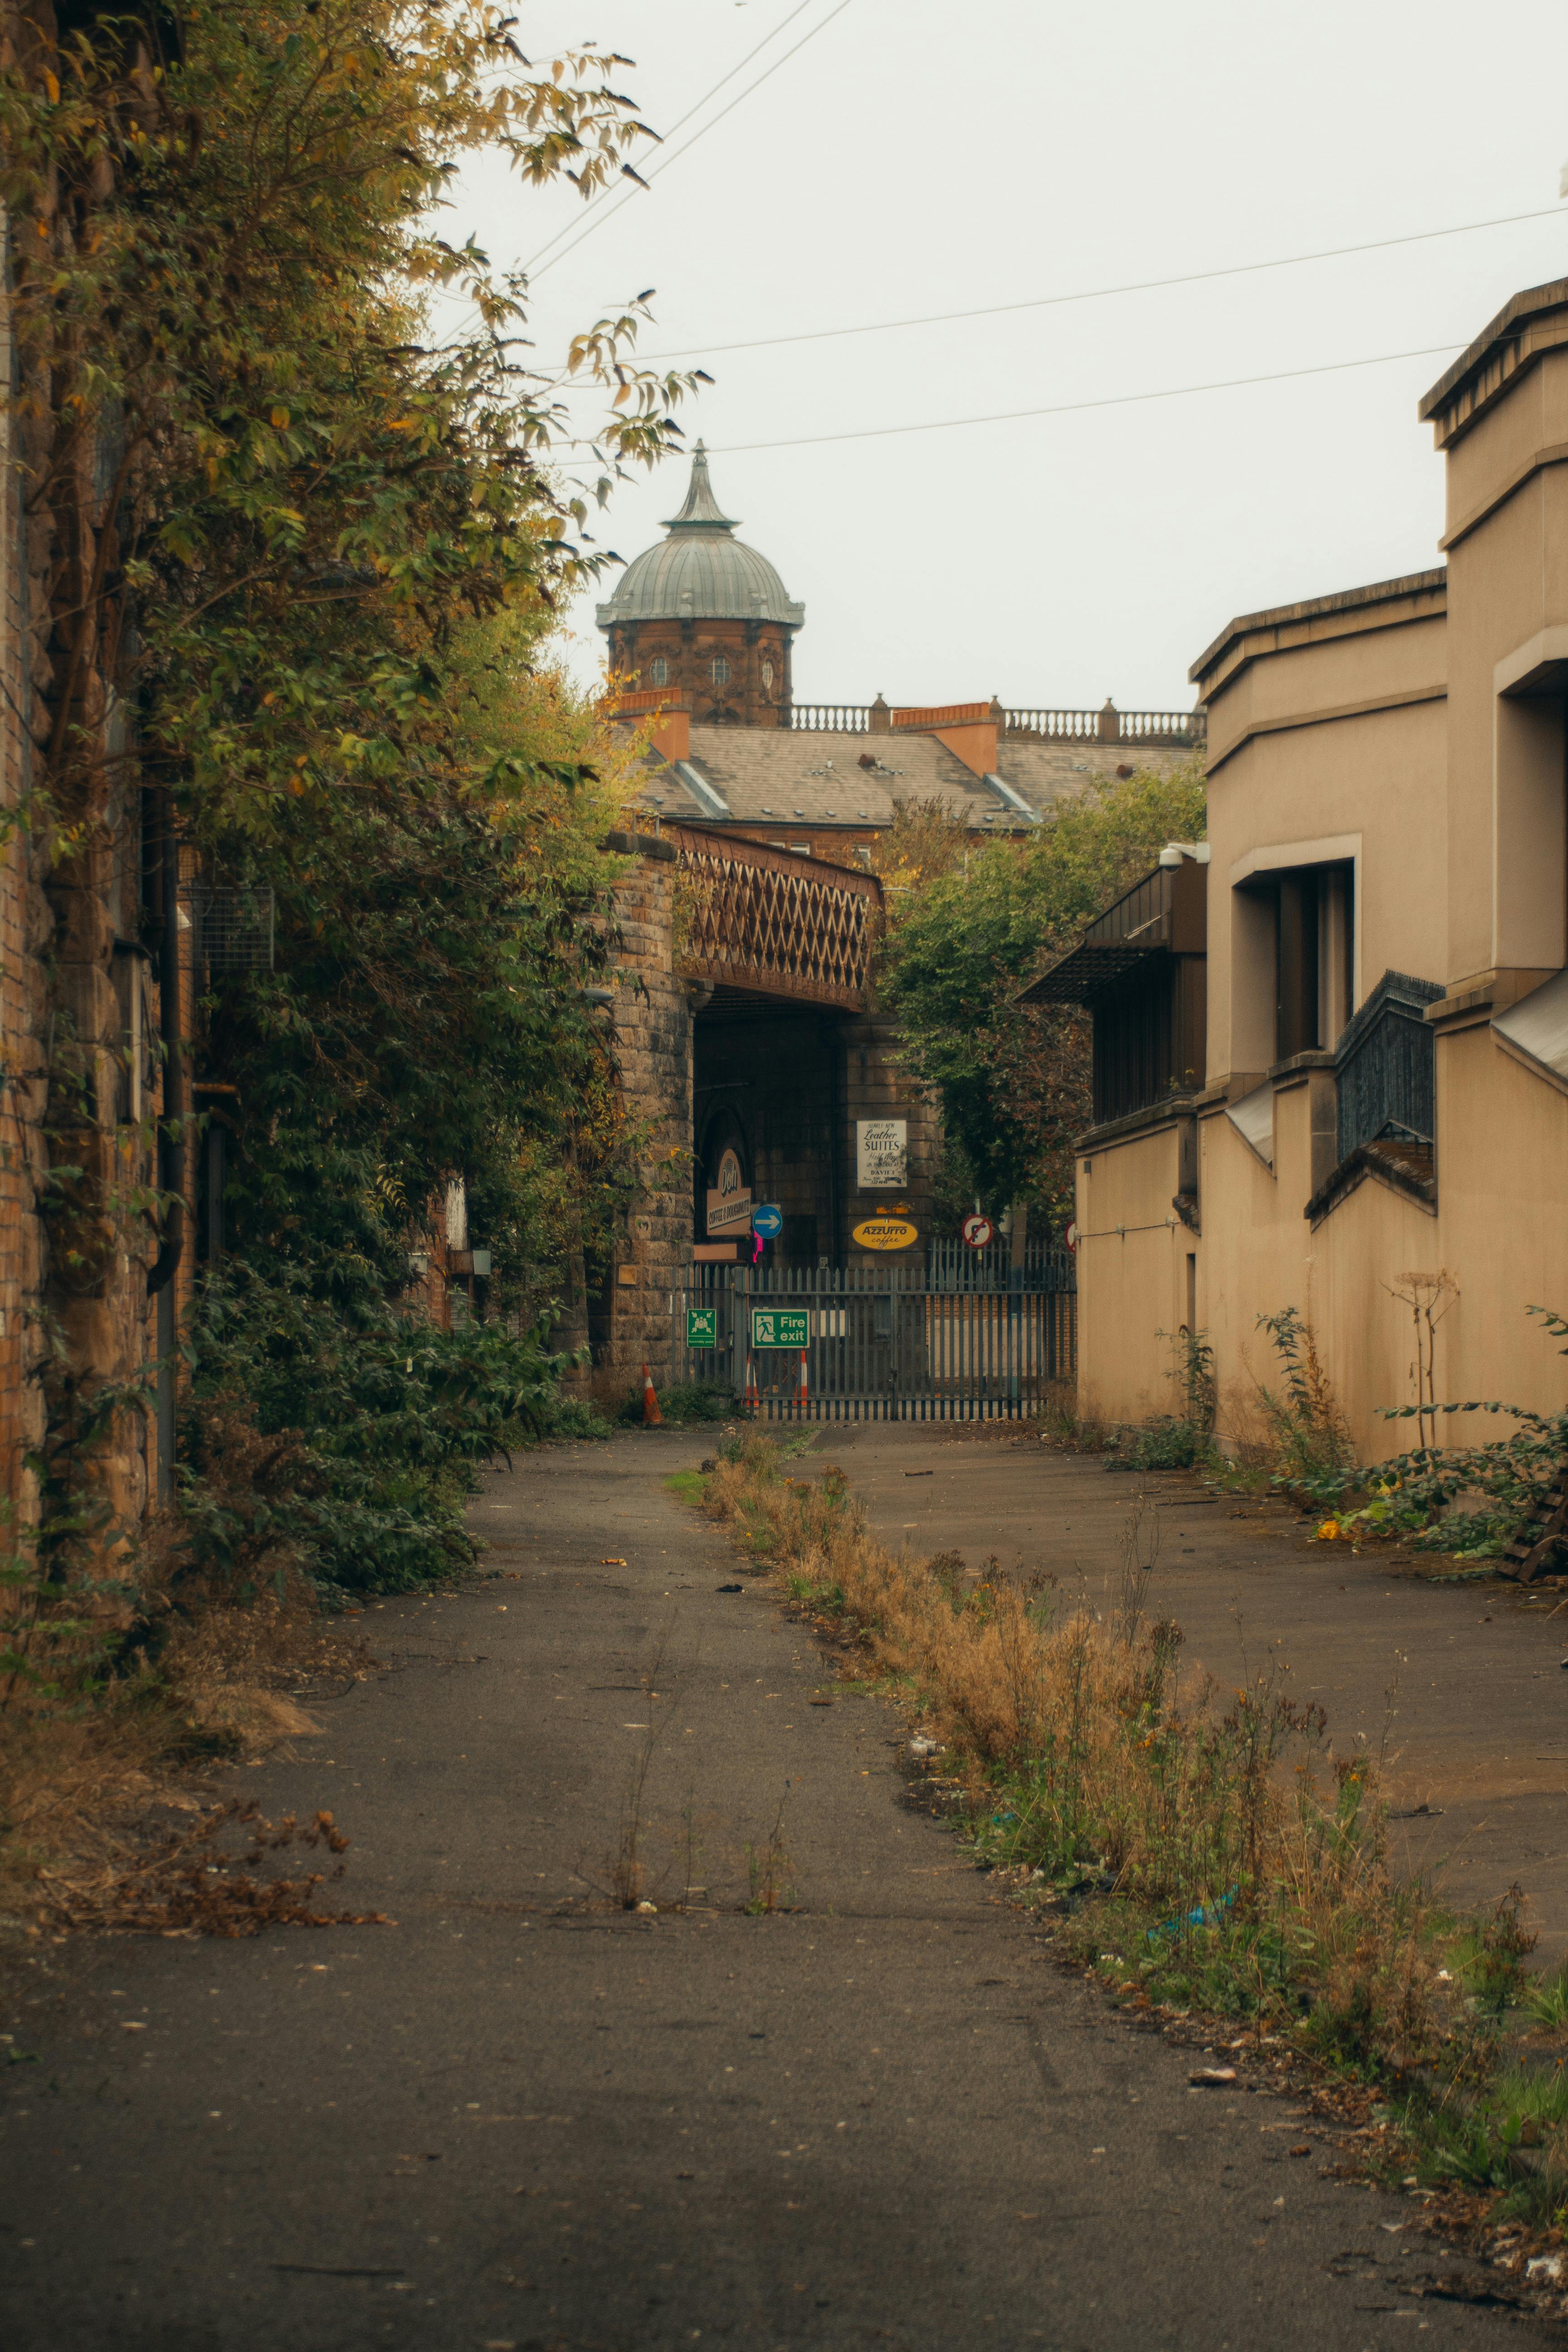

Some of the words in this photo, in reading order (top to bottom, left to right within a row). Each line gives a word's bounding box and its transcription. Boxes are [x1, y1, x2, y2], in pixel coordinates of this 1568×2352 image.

[864, 1128, 897, 1140] Leather
[864, 1141, 900, 1151] SUITES
[721, 1161, 738, 1195] Doh
[709, 1208, 723, 1225] COFFEE
[726, 1199, 750, 1219] DOUGHNUTS
[872, 1235, 900, 1246] coffee
[780, 1317, 805, 1328] Fire
[780, 1330, 804, 1341] exit
